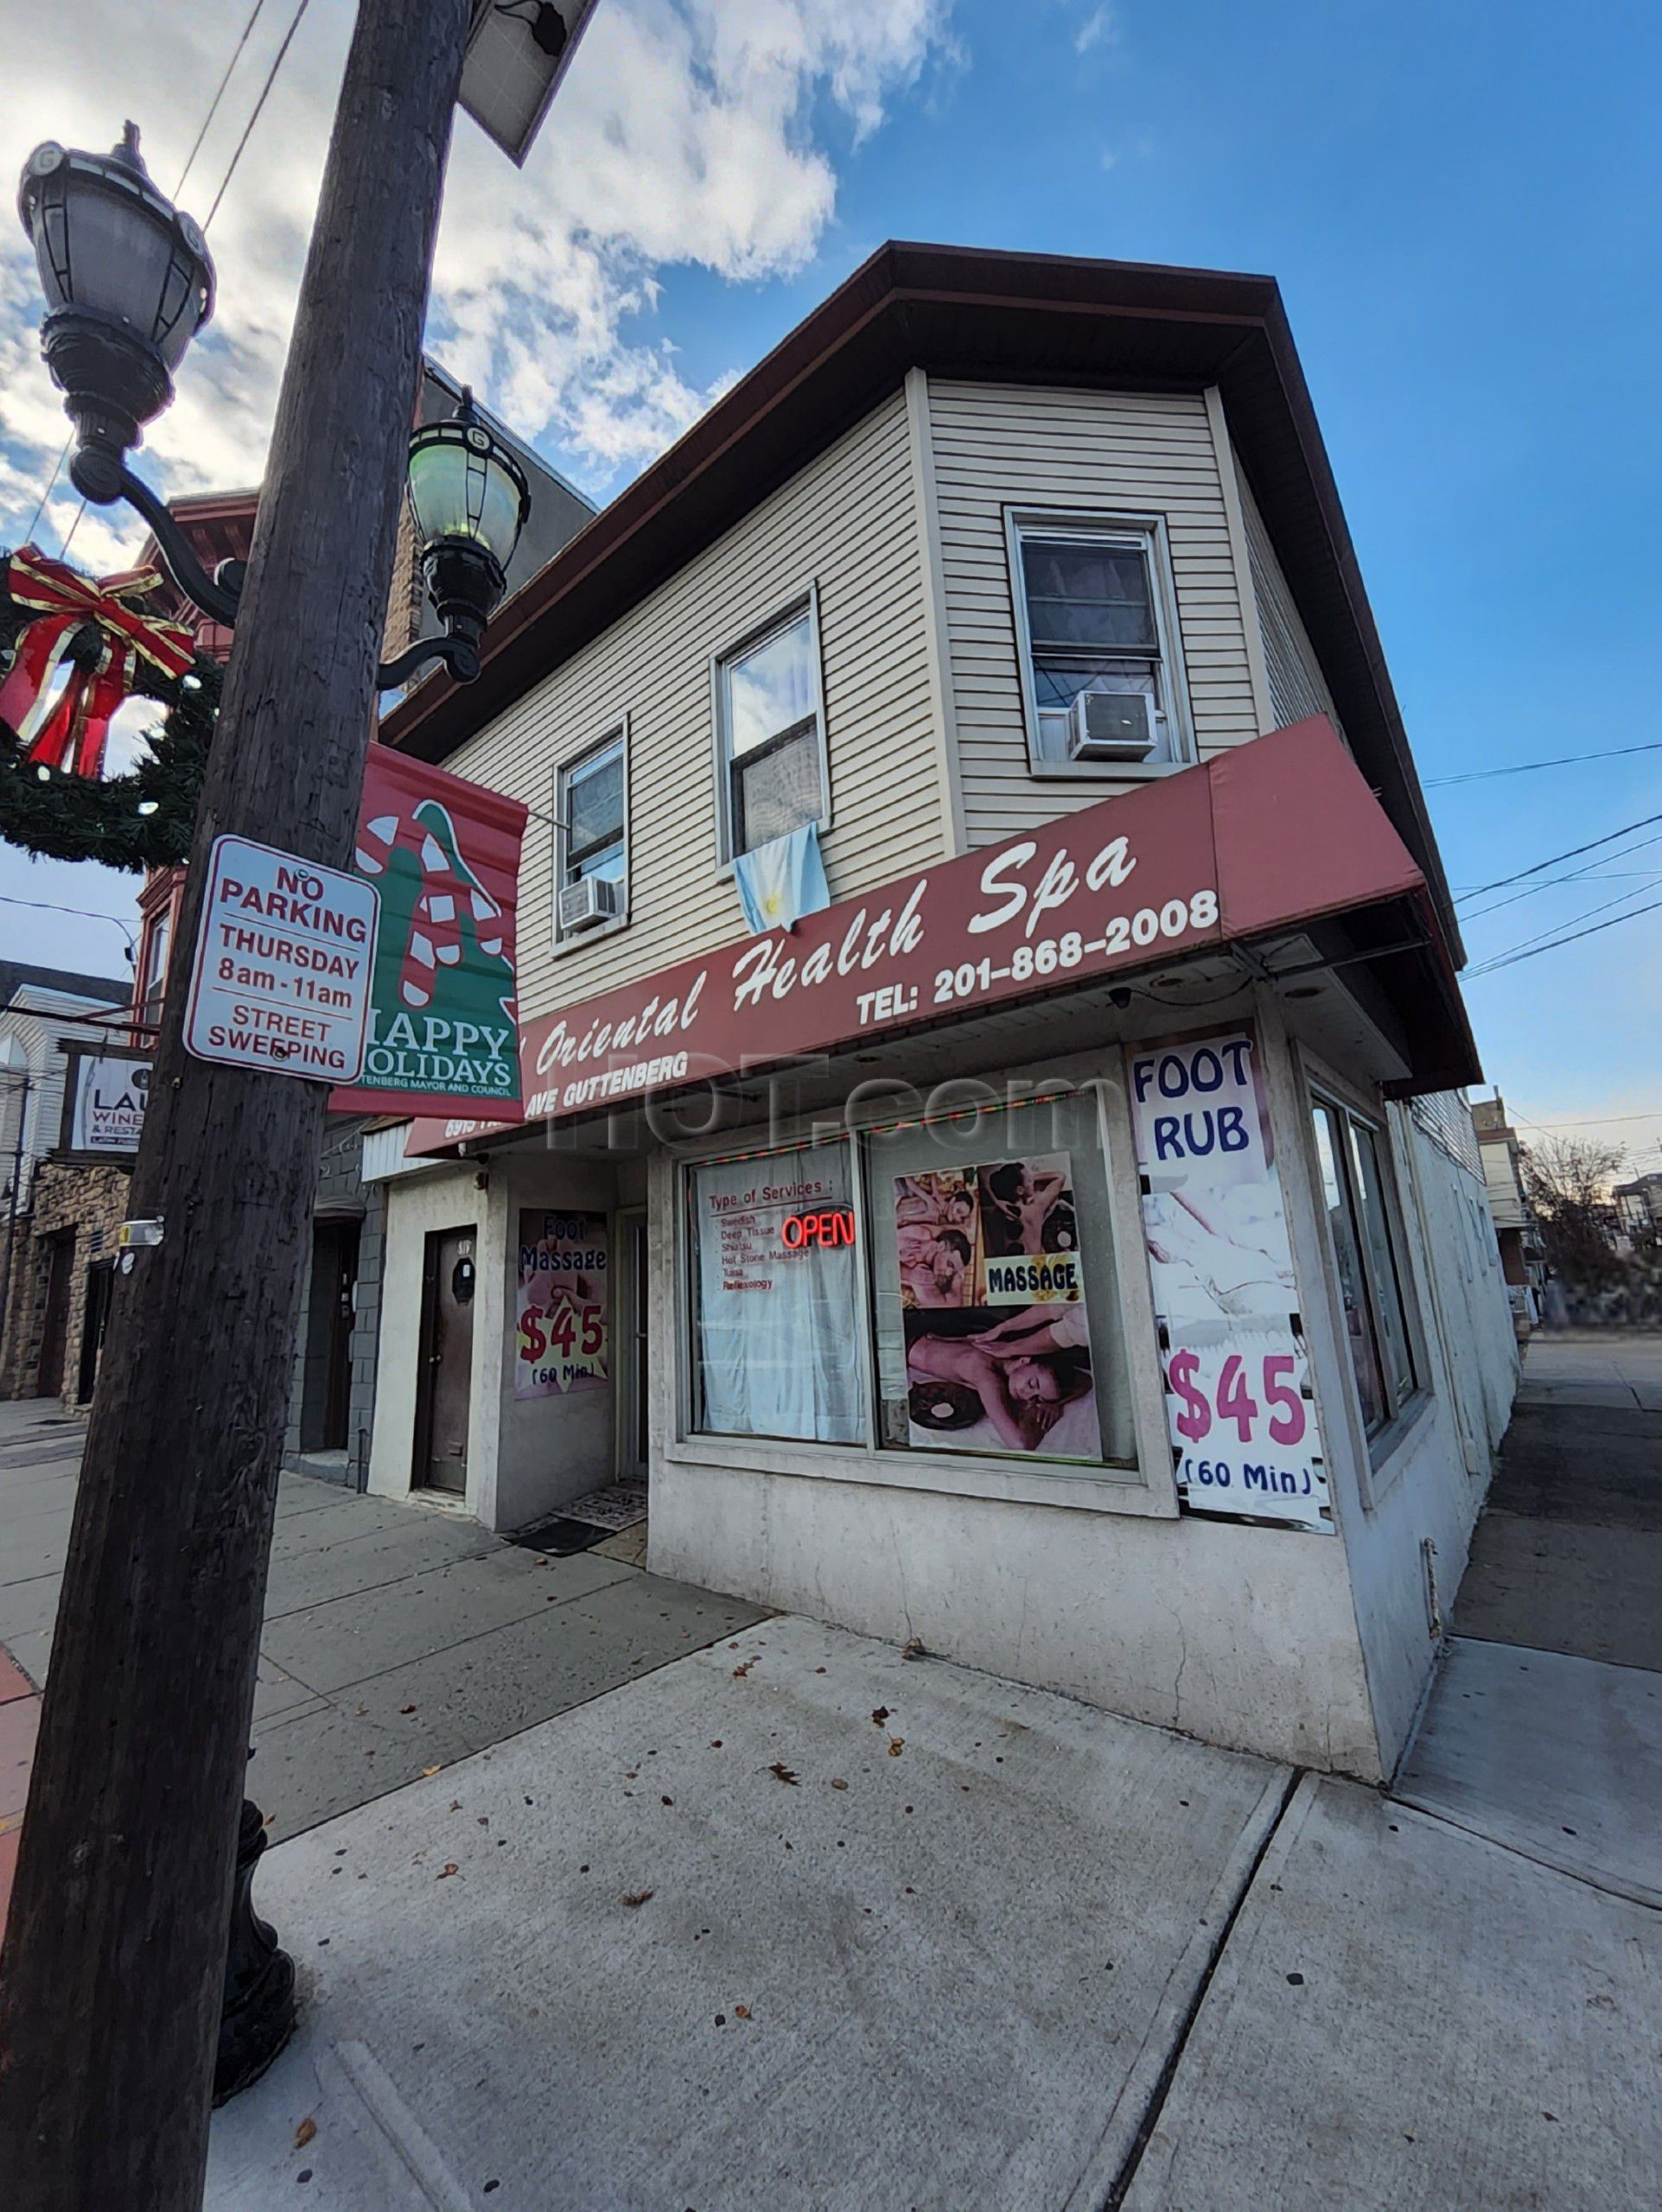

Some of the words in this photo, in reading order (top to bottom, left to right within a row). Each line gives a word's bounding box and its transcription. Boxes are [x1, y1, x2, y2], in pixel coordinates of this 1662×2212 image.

[277, 867, 324, 900] NO
[220, 878, 366, 944] PARKING
[219, 924, 360, 980] THURSDAY
[537, 970, 707, 1076] Oriental
[733, 879, 927, 1011] Health
[967, 836, 1137, 938] Spa
[856, 983, 918, 1024] TEL:
[933, 890, 1219, 1003] 201-868-2008
[232, 1005, 332, 1042] STREET
[208, 1027, 346, 1071] SWEEPING
[365, 1048, 512, 1086] OLIDAYS
[411, 1079, 446, 1091] MAYOR
[448, 1082, 468, 1093] AND
[471, 1084, 512, 1096] COUNCIL
[525, 1090, 556, 1118] AVE
[564, 1052, 689, 1107] GUTTENBERG
[1133, 1040, 1252, 1103] FOOT
[1154, 1106, 1250, 1160] RUB
[709, 1195, 737, 1211] Type
[744, 1189, 756, 1204] of
[721, 1230, 742, 1240] Deep
[781, 1211, 856, 1249] OPEN
[520, 1246, 605, 1271] Massage
[723, 1280, 772, 1290] Reflexology
[988, 1263, 1079, 1293] MASSAGE
[519, 1305, 602, 1363] $45
[1168, 1348, 1306, 1446] $45
[1185, 1459, 1231, 1488] (60
[1244, 1464, 1311, 1495] Min)
